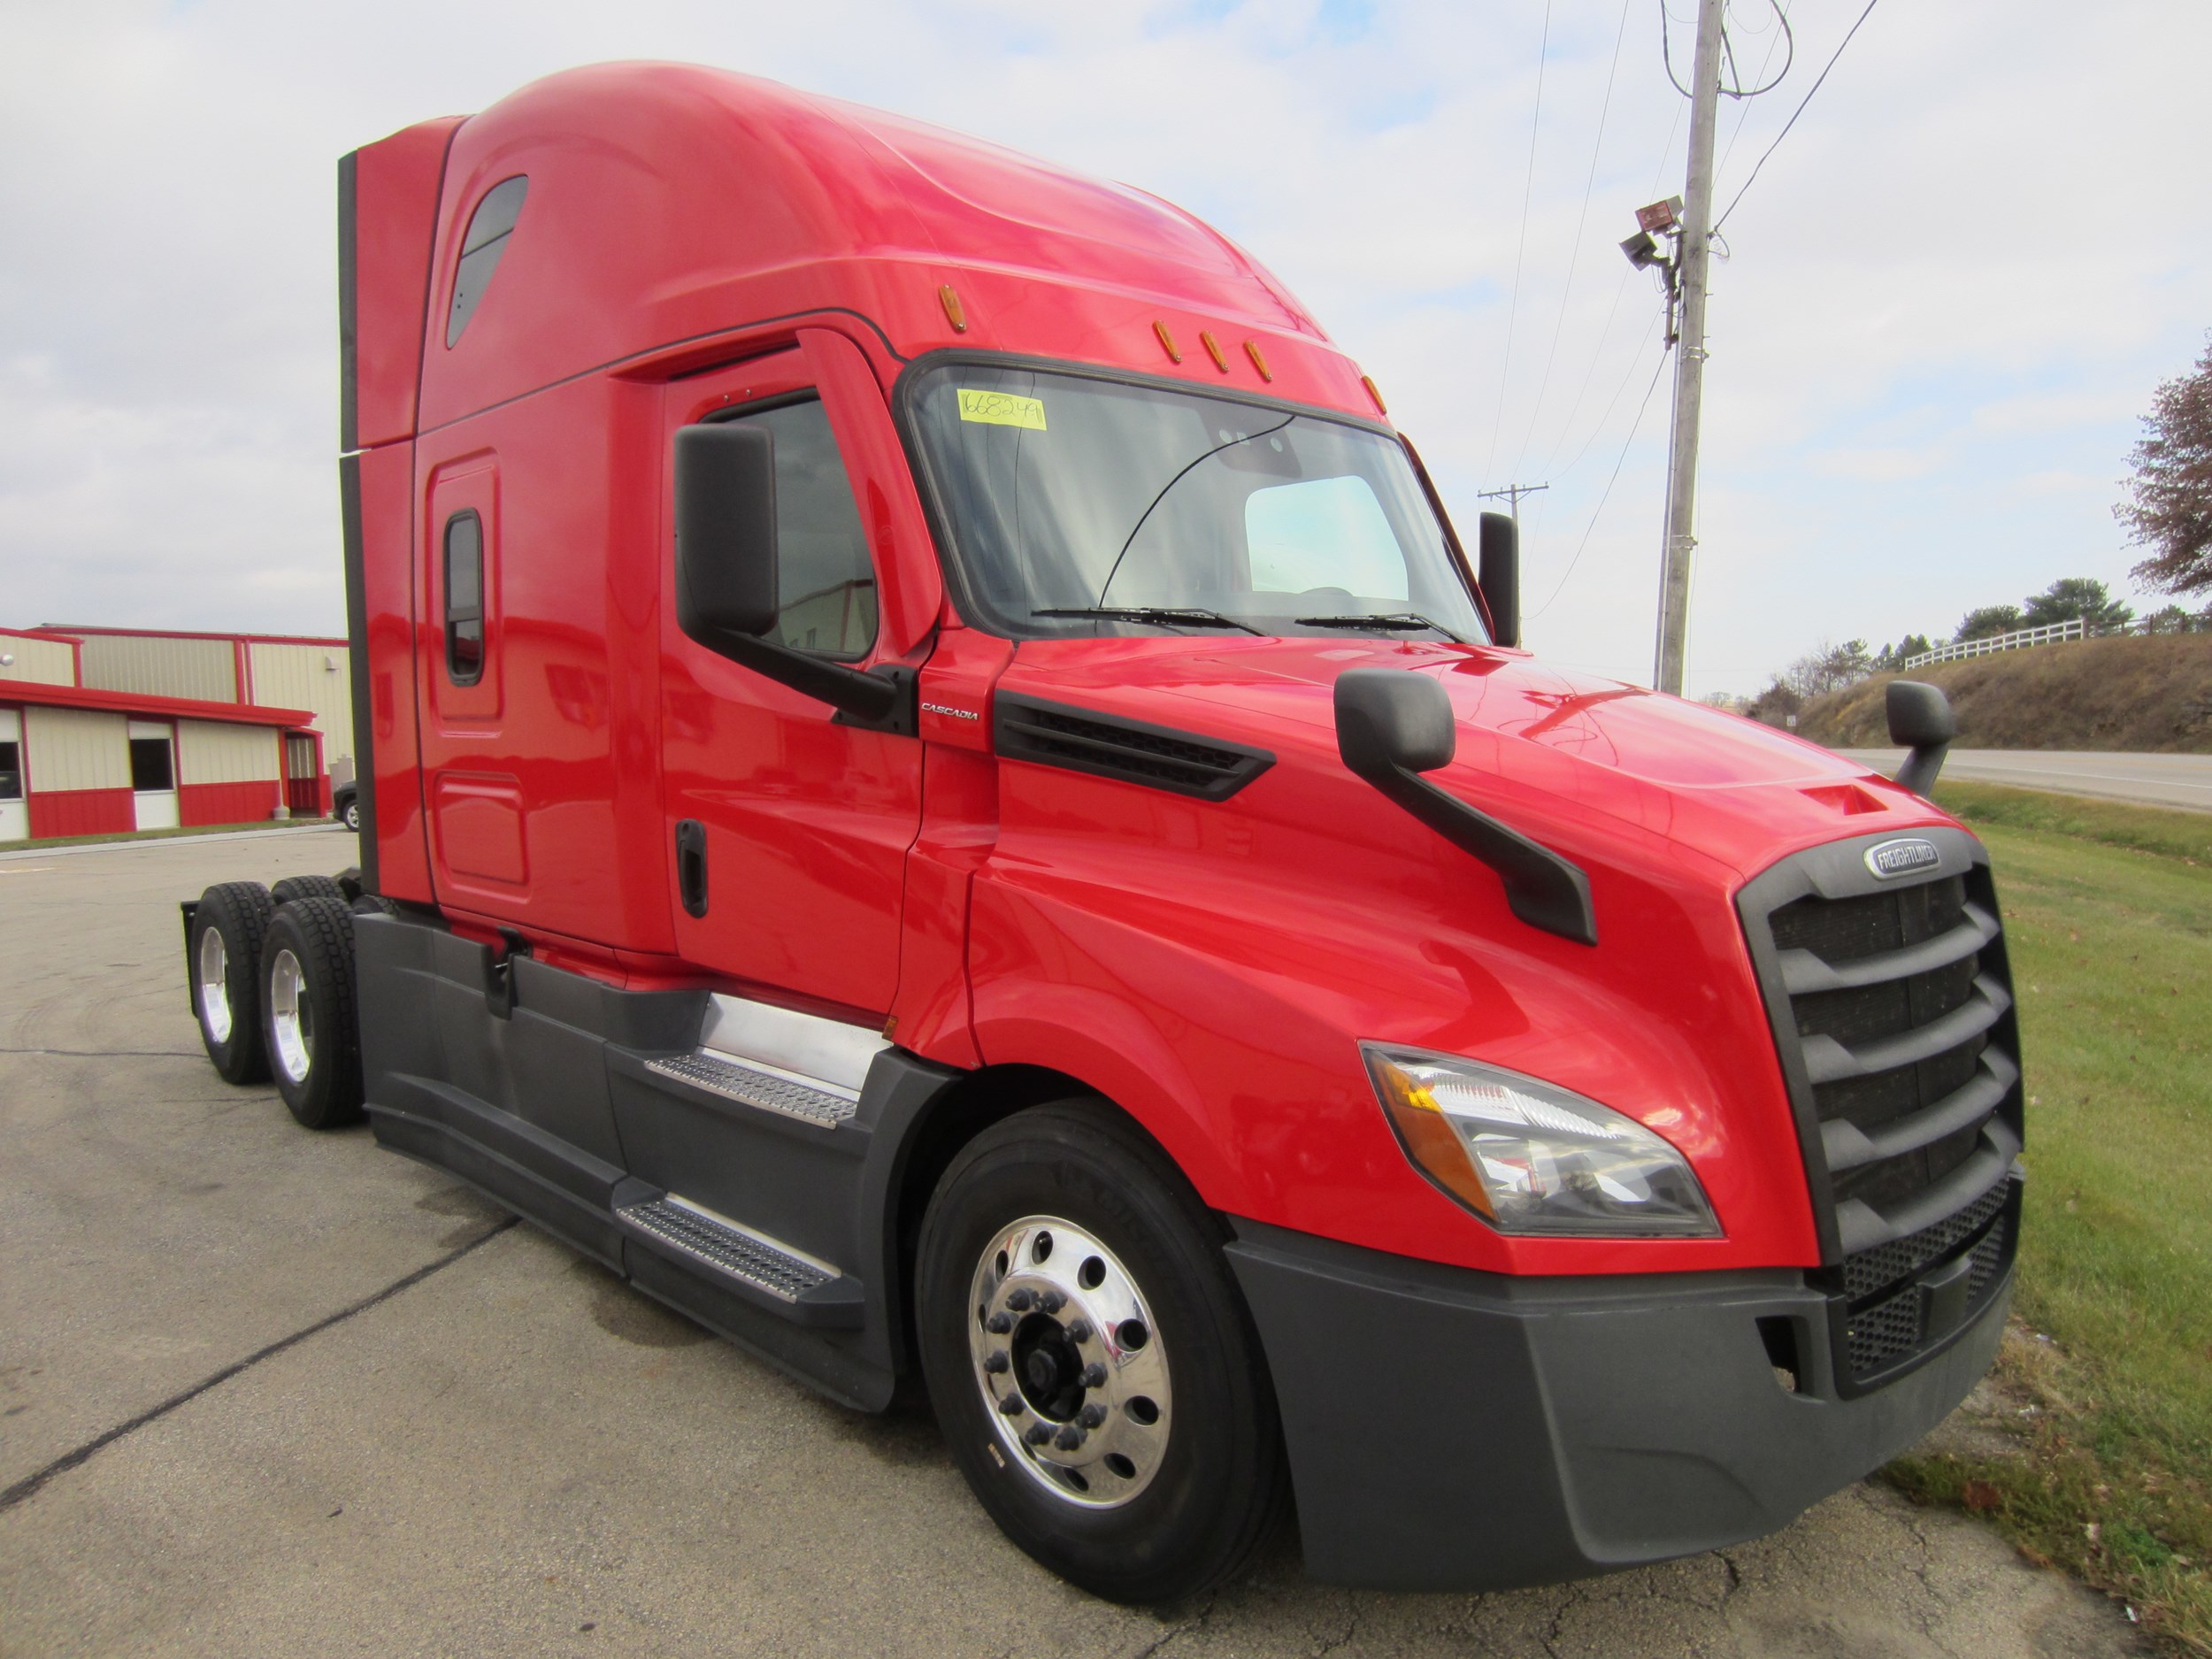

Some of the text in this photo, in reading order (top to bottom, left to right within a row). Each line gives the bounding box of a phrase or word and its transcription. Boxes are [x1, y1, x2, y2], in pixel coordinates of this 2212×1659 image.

[964, 392, 1042, 423] 668249
[921, 703, 978, 720] CASCADIA
[1877, 845, 1936, 870] FREIGHTLINER
